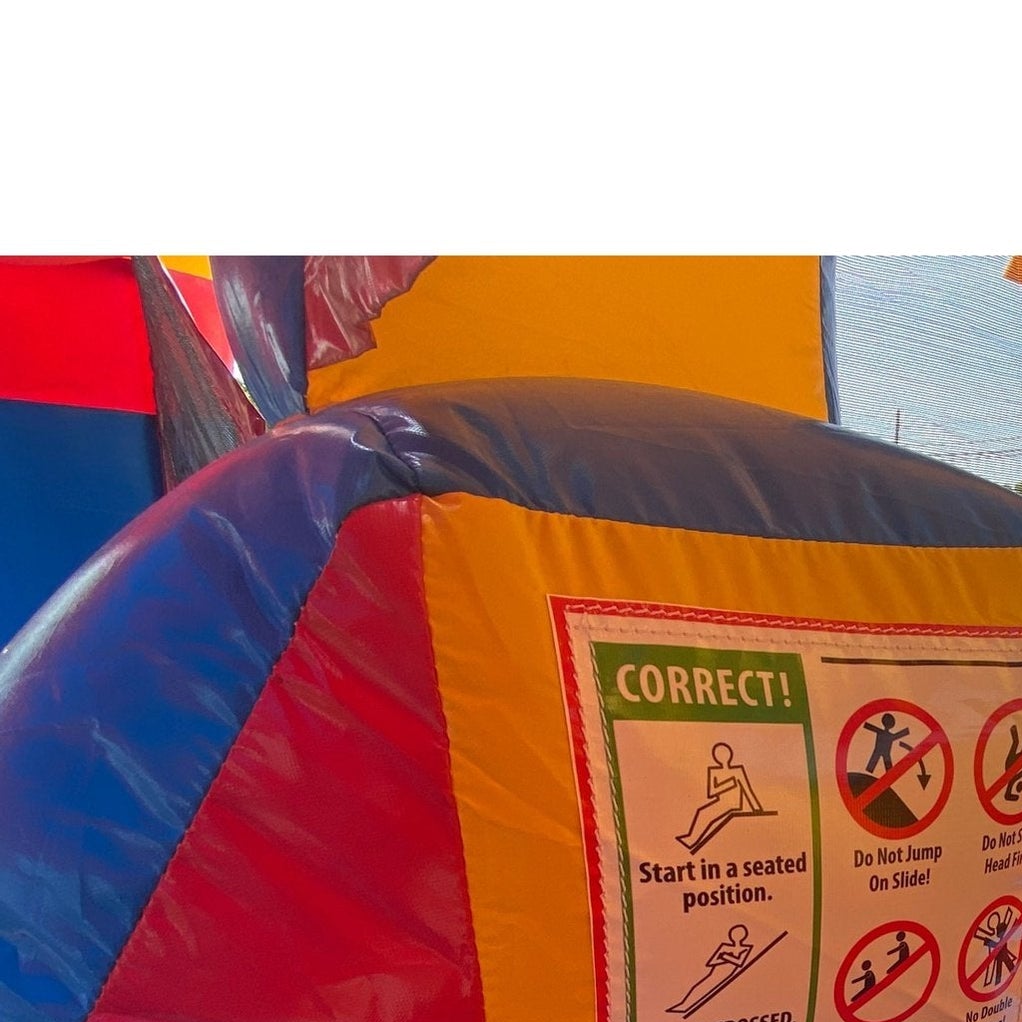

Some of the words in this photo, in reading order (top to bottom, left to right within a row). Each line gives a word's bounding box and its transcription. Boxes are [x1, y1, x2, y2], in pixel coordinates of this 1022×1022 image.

[616, 664, 792, 708] CORRECT!
[982, 835, 996, 851] Do
[1000, 832, 1015, 848] Not
[639, 861, 696, 883] Start
[701, 858, 720, 879] in
[726, 863, 737, 877] a
[743, 852, 806, 877] seated
[854, 850, 873, 868] Do
[877, 848, 902, 865] Not
[905, 845, 942, 863] Jump
[984, 852, 1010, 874] Head
[869, 875, 888, 892] On
[892, 869, 930, 889] Slide!
[683, 883, 772, 913] position.
[981, 997, 1013, 1020] Double
